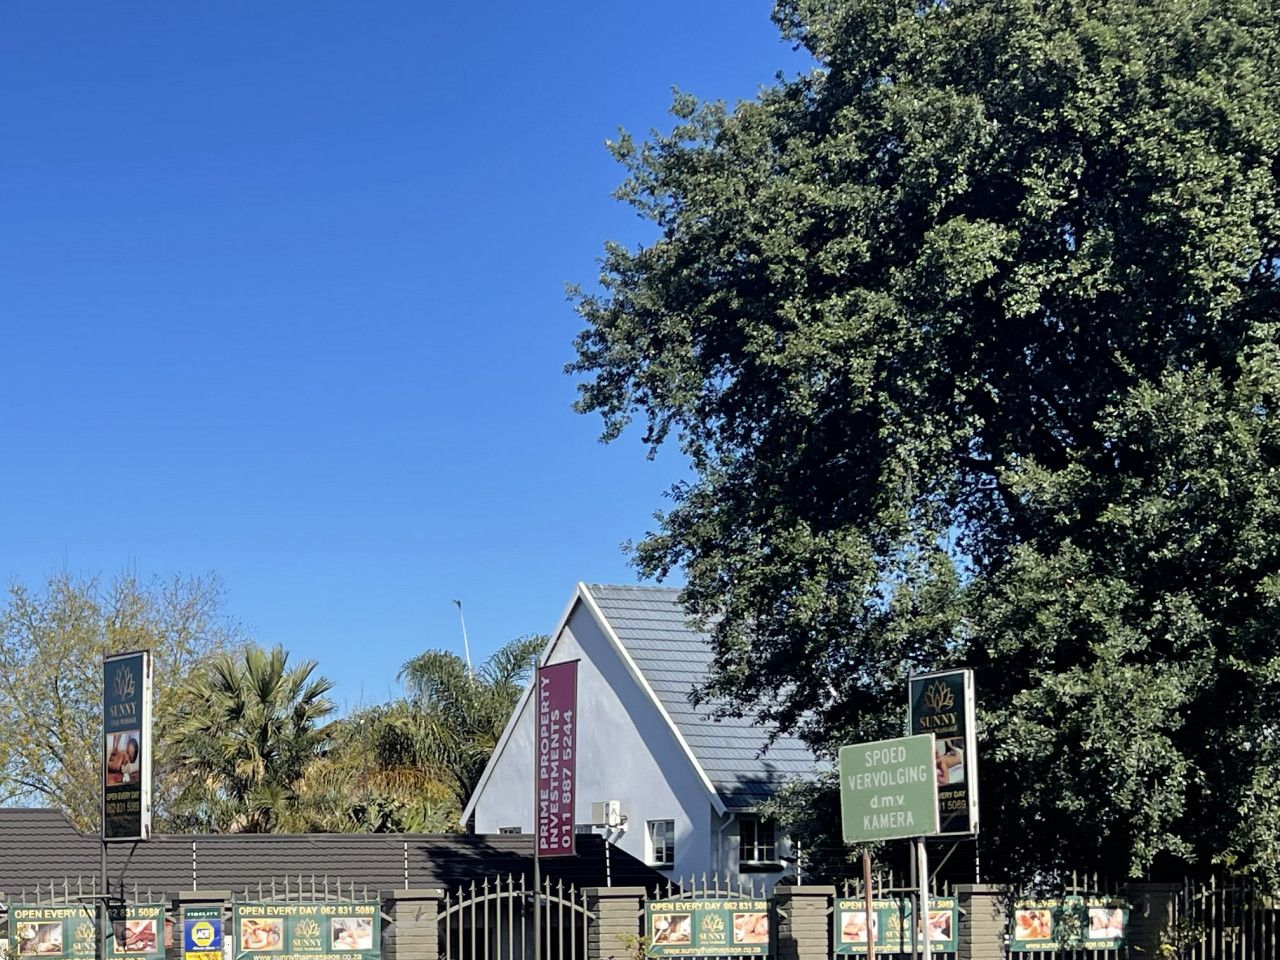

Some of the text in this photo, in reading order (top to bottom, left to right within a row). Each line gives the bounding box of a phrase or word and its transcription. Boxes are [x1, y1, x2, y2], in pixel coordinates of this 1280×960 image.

[109, 701, 137, 717] SUNNY
[919, 712, 958, 728] SUNNY
[540, 676, 551, 850] PRIME PROPERTY
[864, 746, 907, 768] SPOED
[550, 709, 560, 849] INVESTMENTS
[561, 709, 573, 848] 011 887 5244
[847, 765, 928, 791] VERVOLGING
[863, 810, 915, 831] KAMERA
[15, 909, 42, 919] OPEN
[45, 909, 77, 919] EVERY
[238, 905, 376, 916] OPEN EVERY DAY 062 831 5089
[650, 902, 674, 911] OPEN
[675, 902, 703, 911] EVERY
[704, 902, 721, 910] DAY
[723, 901, 738, 911] 062
[738, 901, 753, 910] 831
[292, 938, 322, 946] SUNNY
[699, 932, 726, 940] SUNNY
